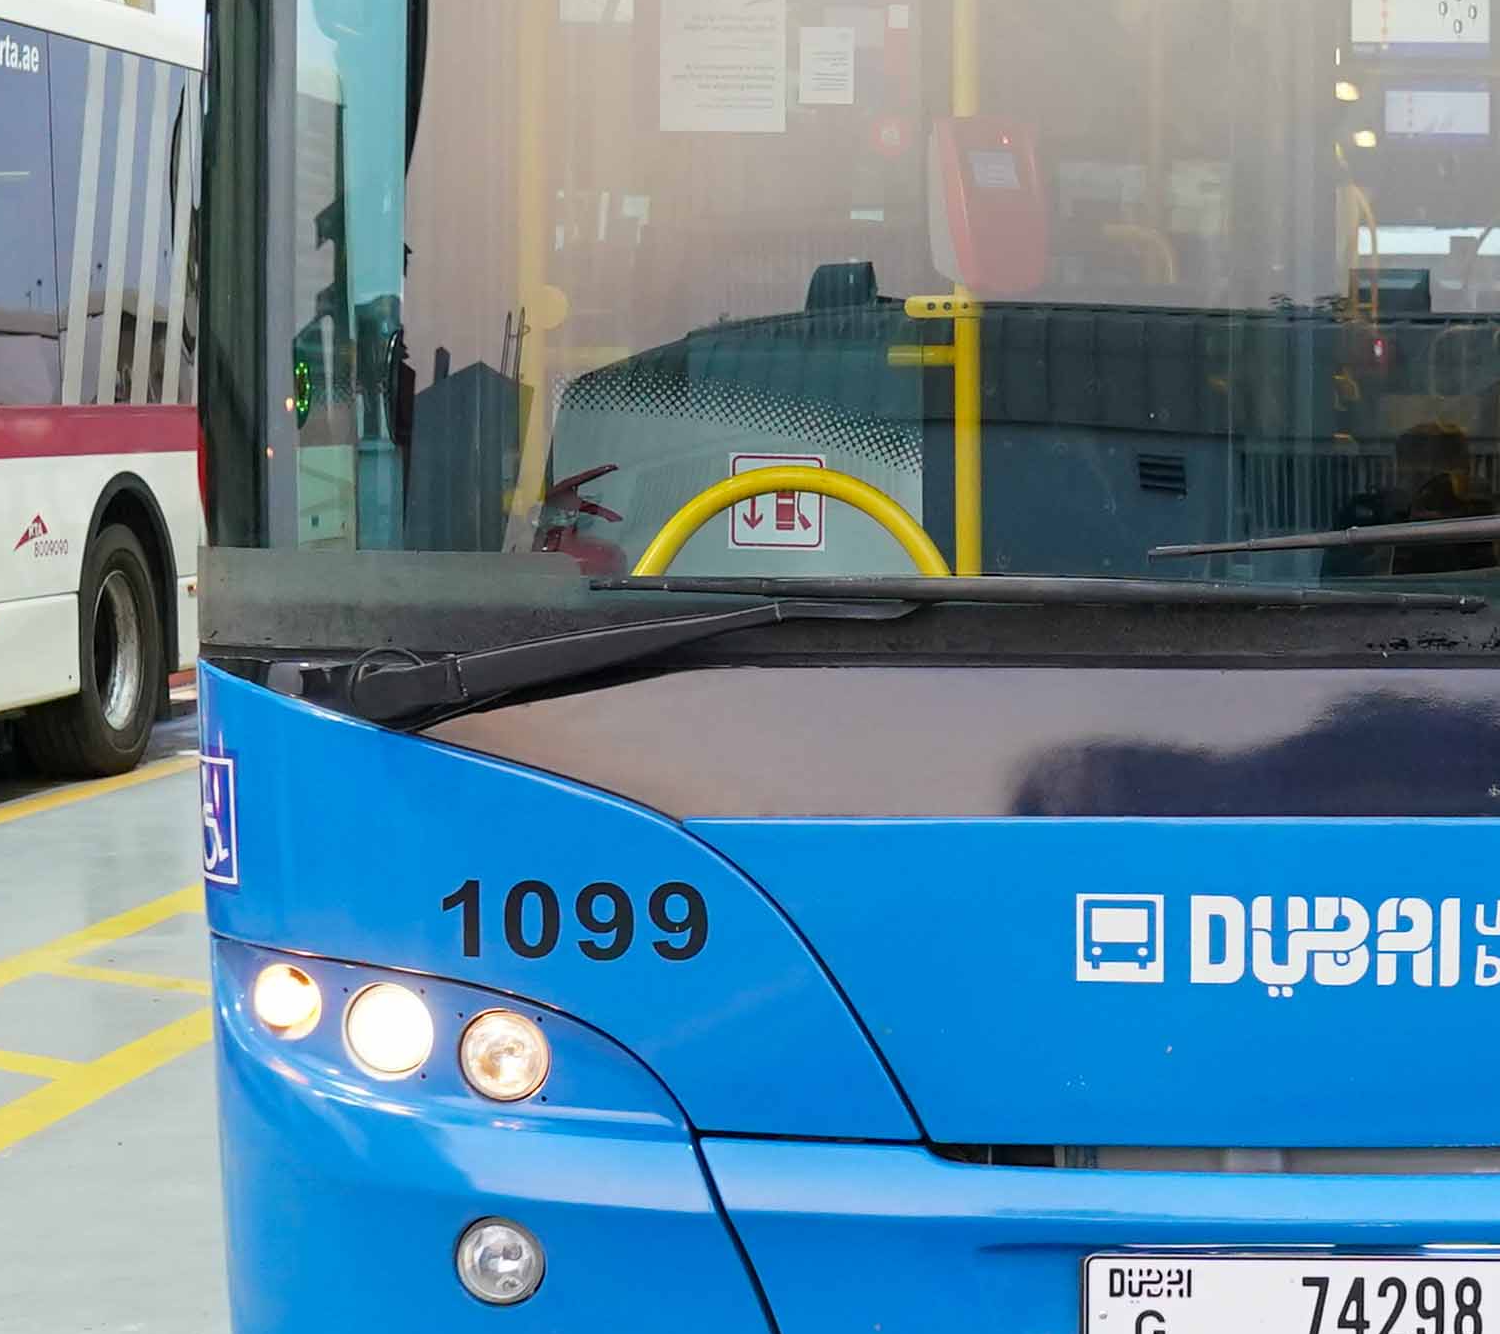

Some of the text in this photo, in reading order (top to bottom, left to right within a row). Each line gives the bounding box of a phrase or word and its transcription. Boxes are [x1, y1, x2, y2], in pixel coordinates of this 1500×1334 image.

[442, 878, 709, 961] 1099
[1190, 895, 1461, 997] DUBAI
[1109, 1268, 1192, 1299] DUBAI
